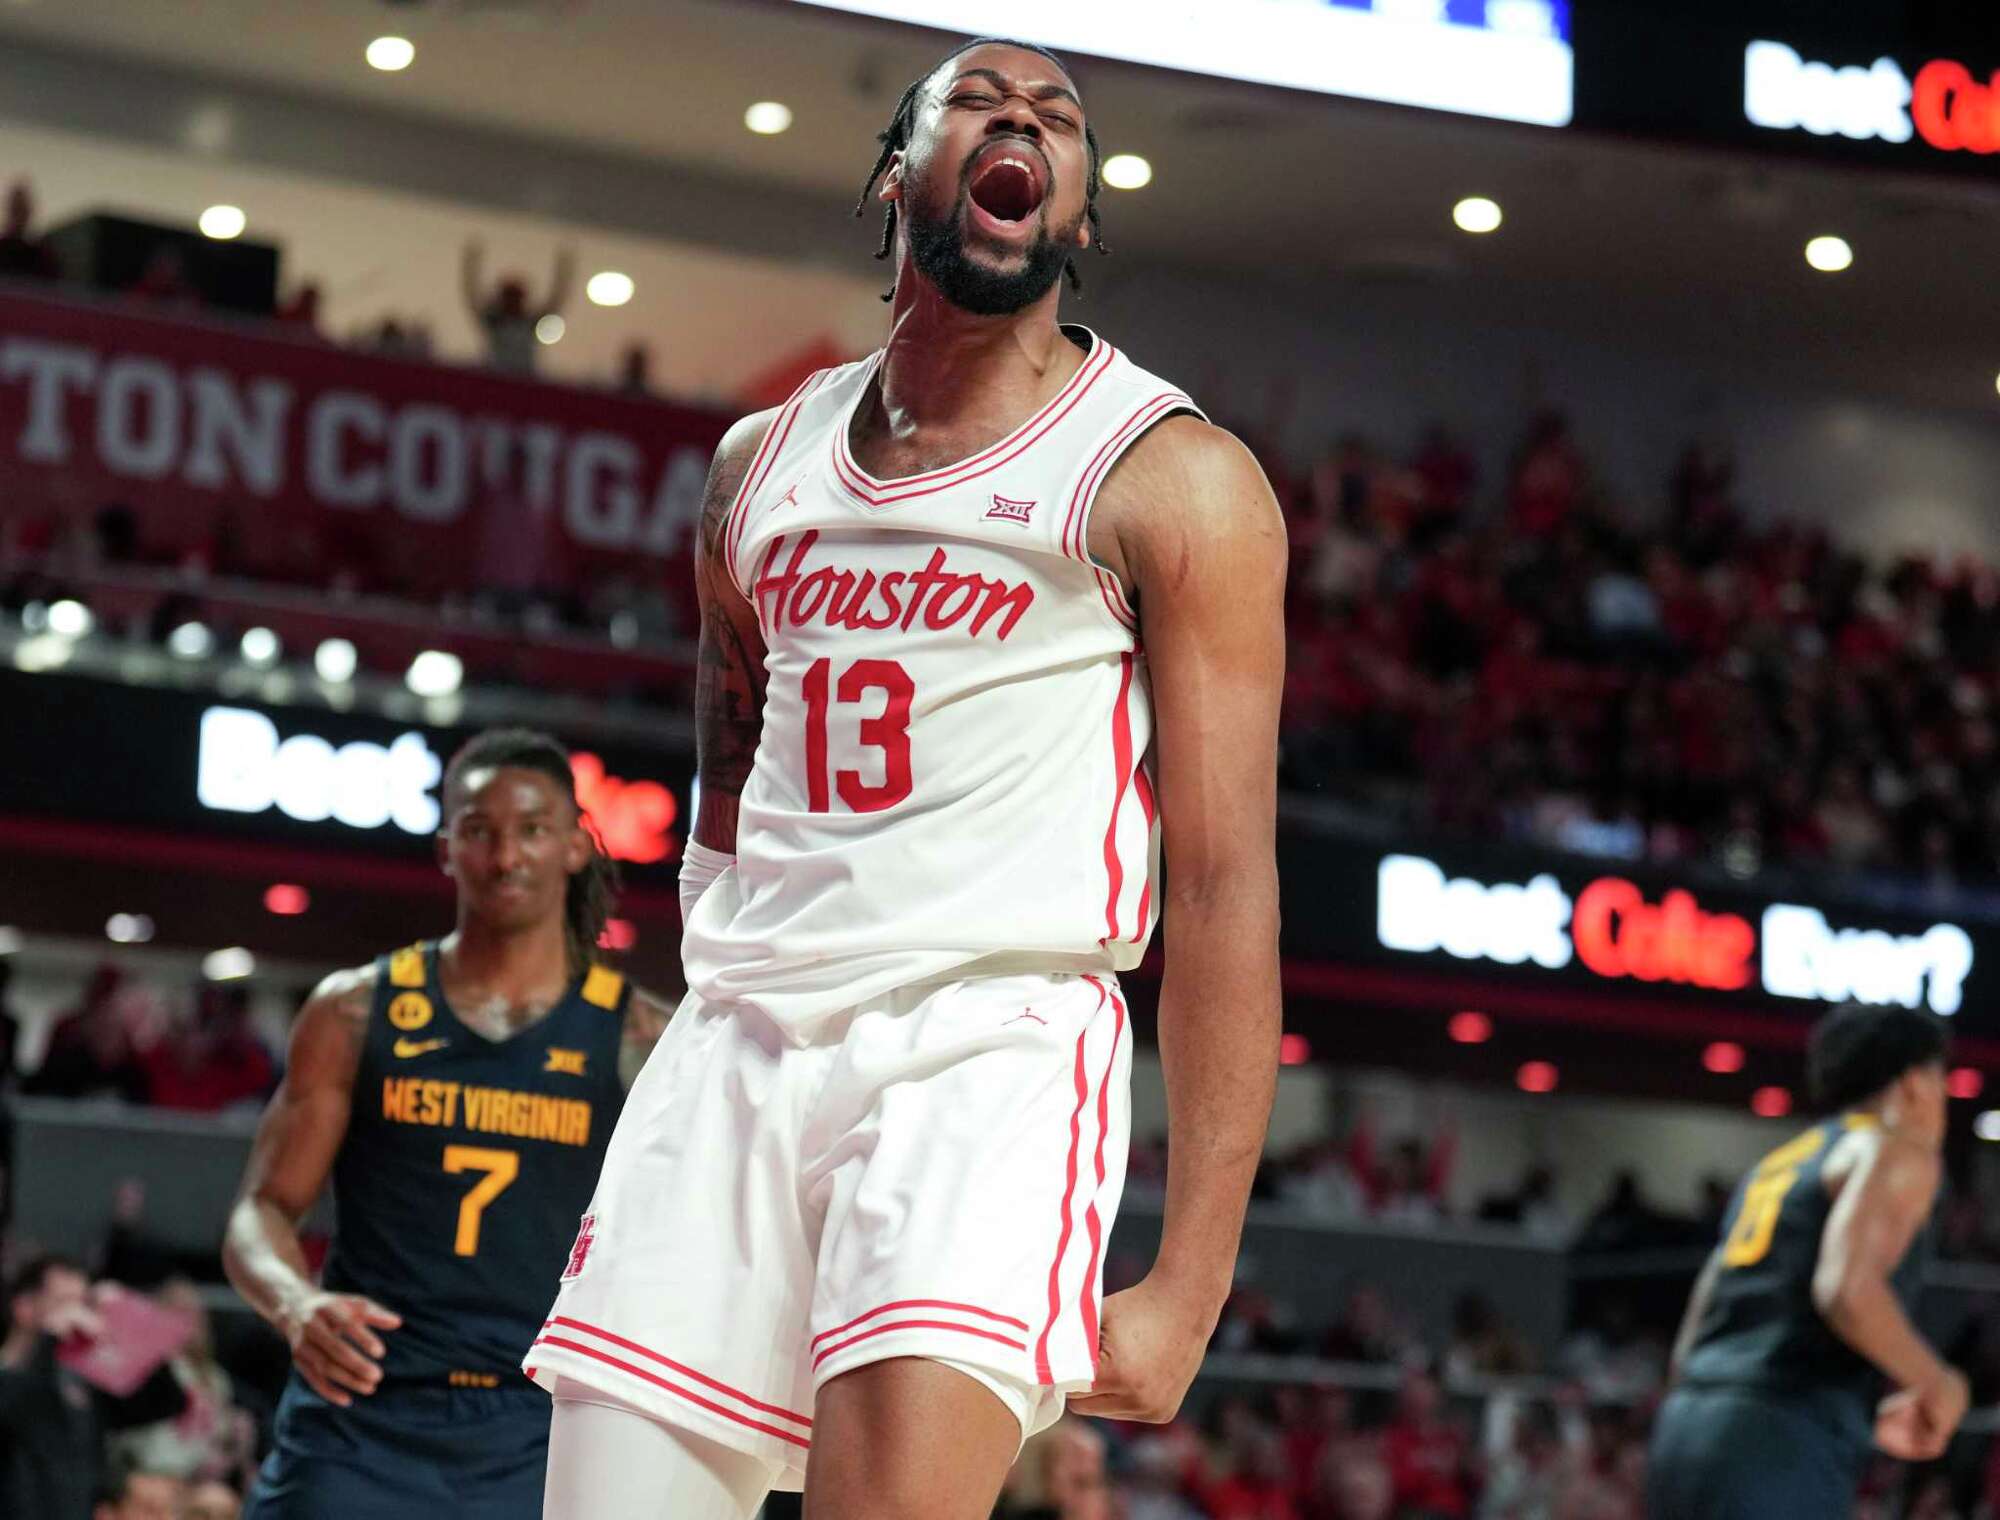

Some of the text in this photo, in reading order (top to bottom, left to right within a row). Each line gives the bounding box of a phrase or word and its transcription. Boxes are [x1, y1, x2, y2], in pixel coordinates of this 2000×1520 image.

[0, 338, 293, 498] TON
[755, 529, 1035, 641] Houston
[802, 658, 915, 813] 13
[383, 1076, 592, 1147] WEST VIRGINIA
[442, 1145, 520, 1257] 7
